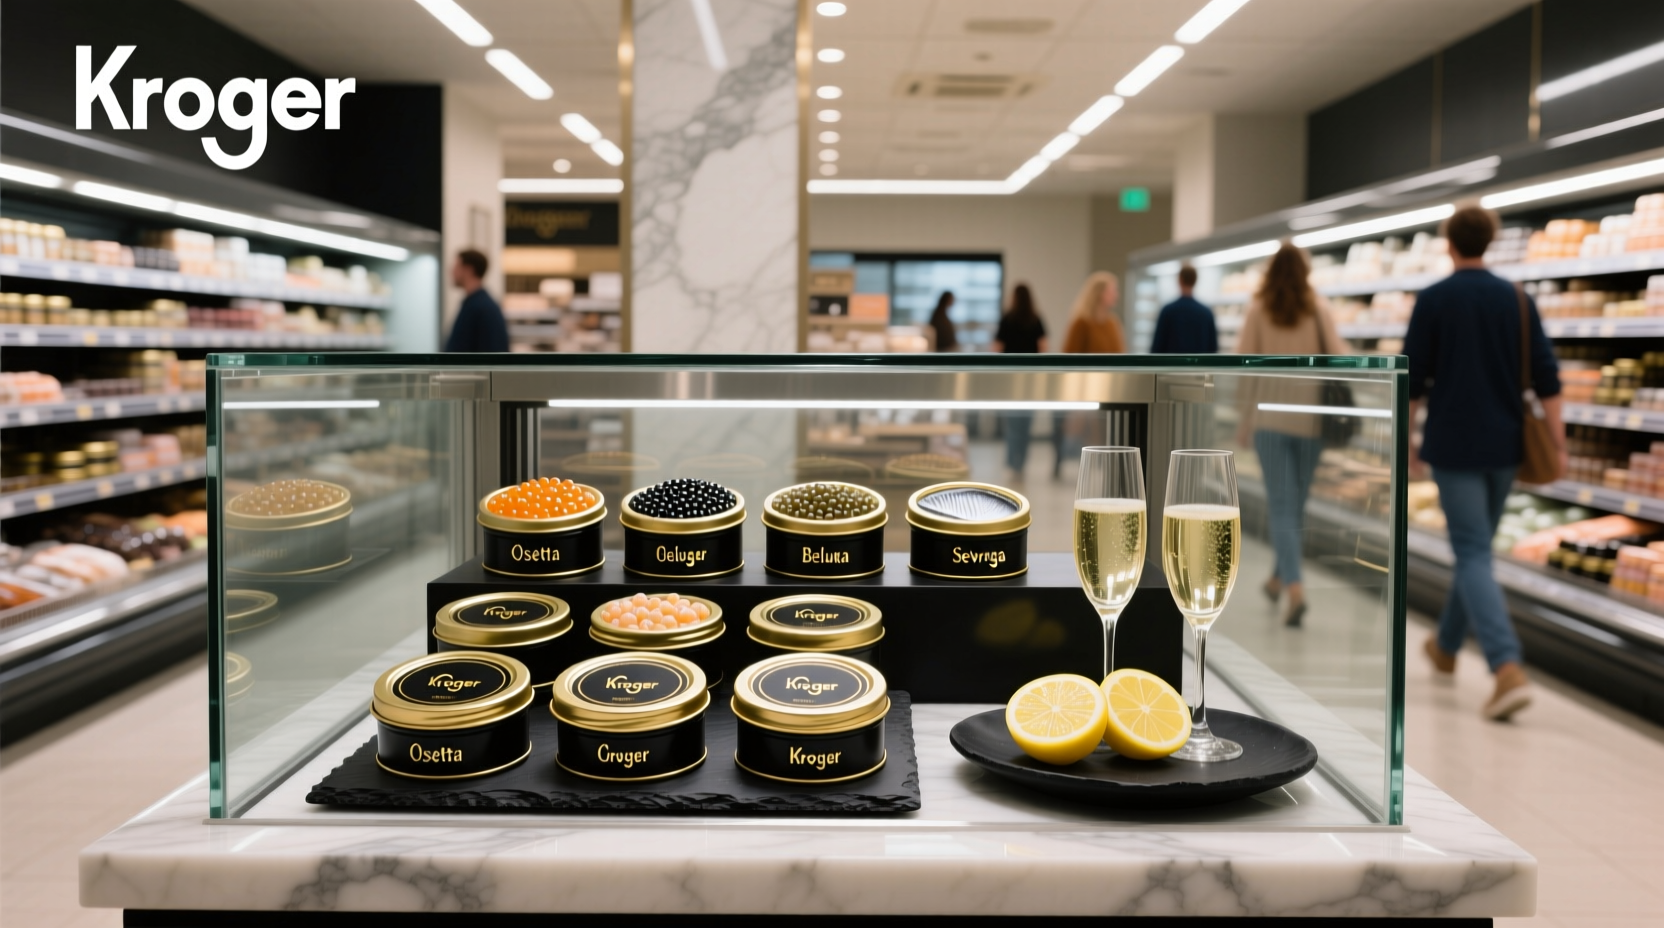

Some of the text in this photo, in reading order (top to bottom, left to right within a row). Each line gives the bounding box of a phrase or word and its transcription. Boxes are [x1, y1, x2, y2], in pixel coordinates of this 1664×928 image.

[428, 673, 481, 692] Kroger
[605, 675, 659, 694] Kroger
[785, 676, 838, 696] Kroger
[409, 742, 462, 763] Osetta
[789, 746, 841, 770] Kroger
